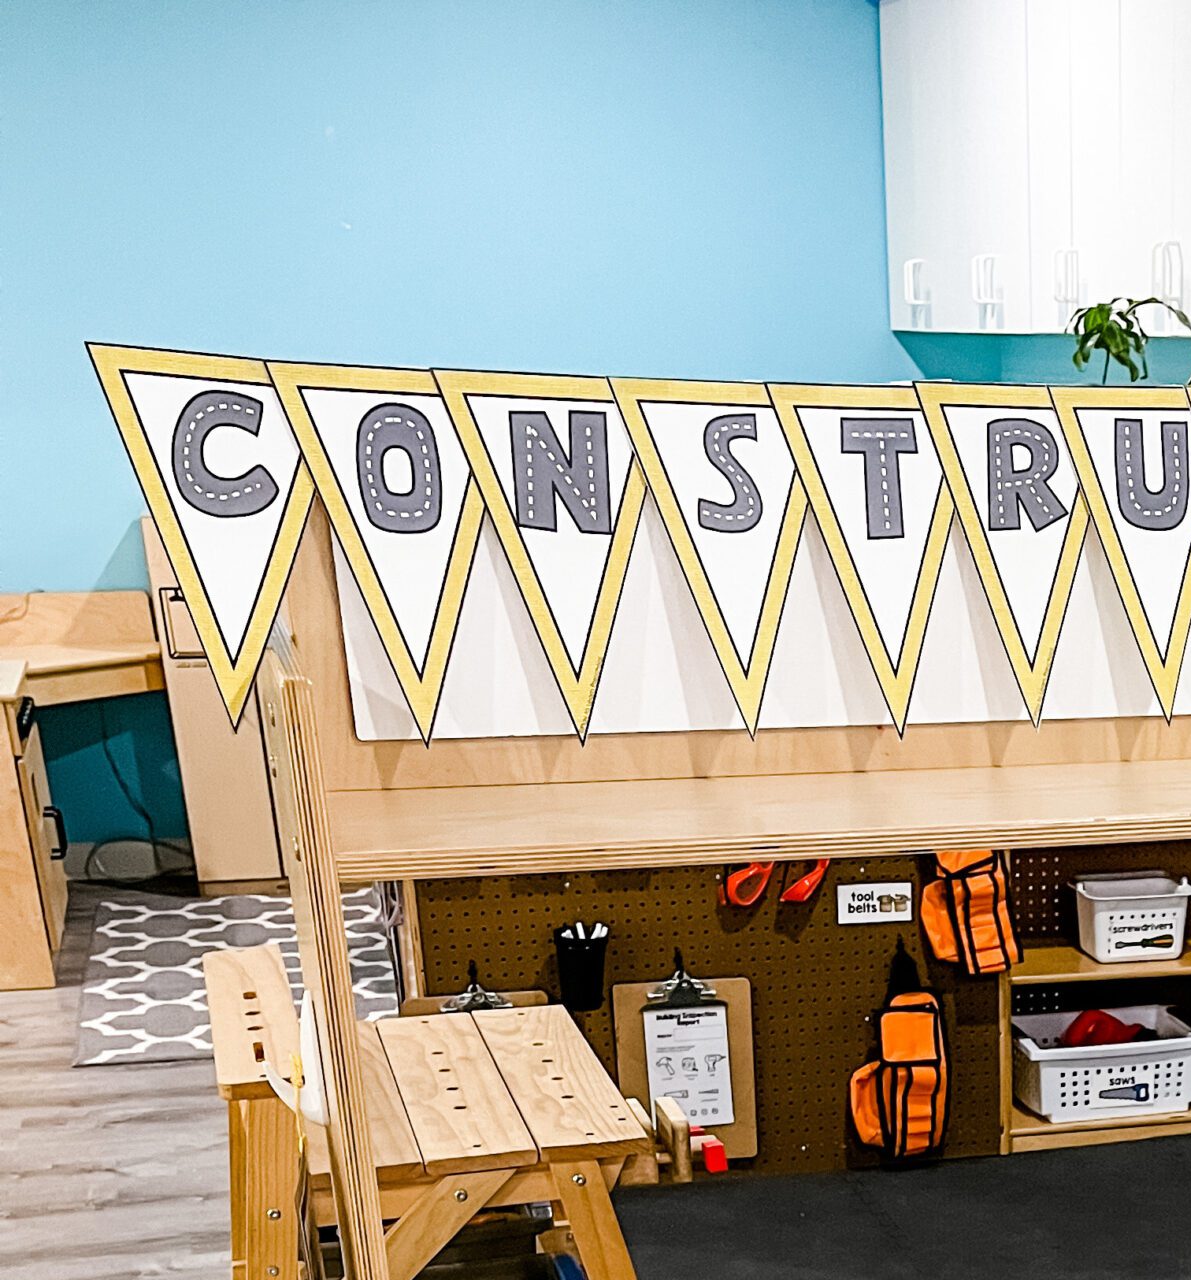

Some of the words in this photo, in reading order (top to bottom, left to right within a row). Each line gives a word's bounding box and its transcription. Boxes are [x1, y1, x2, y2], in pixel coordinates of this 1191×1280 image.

[851, 890, 874, 902] tool
[847, 903, 878, 914] belts
[1112, 922, 1174, 934] screwdrivers
[1109, 1075, 1136, 1086] saws
